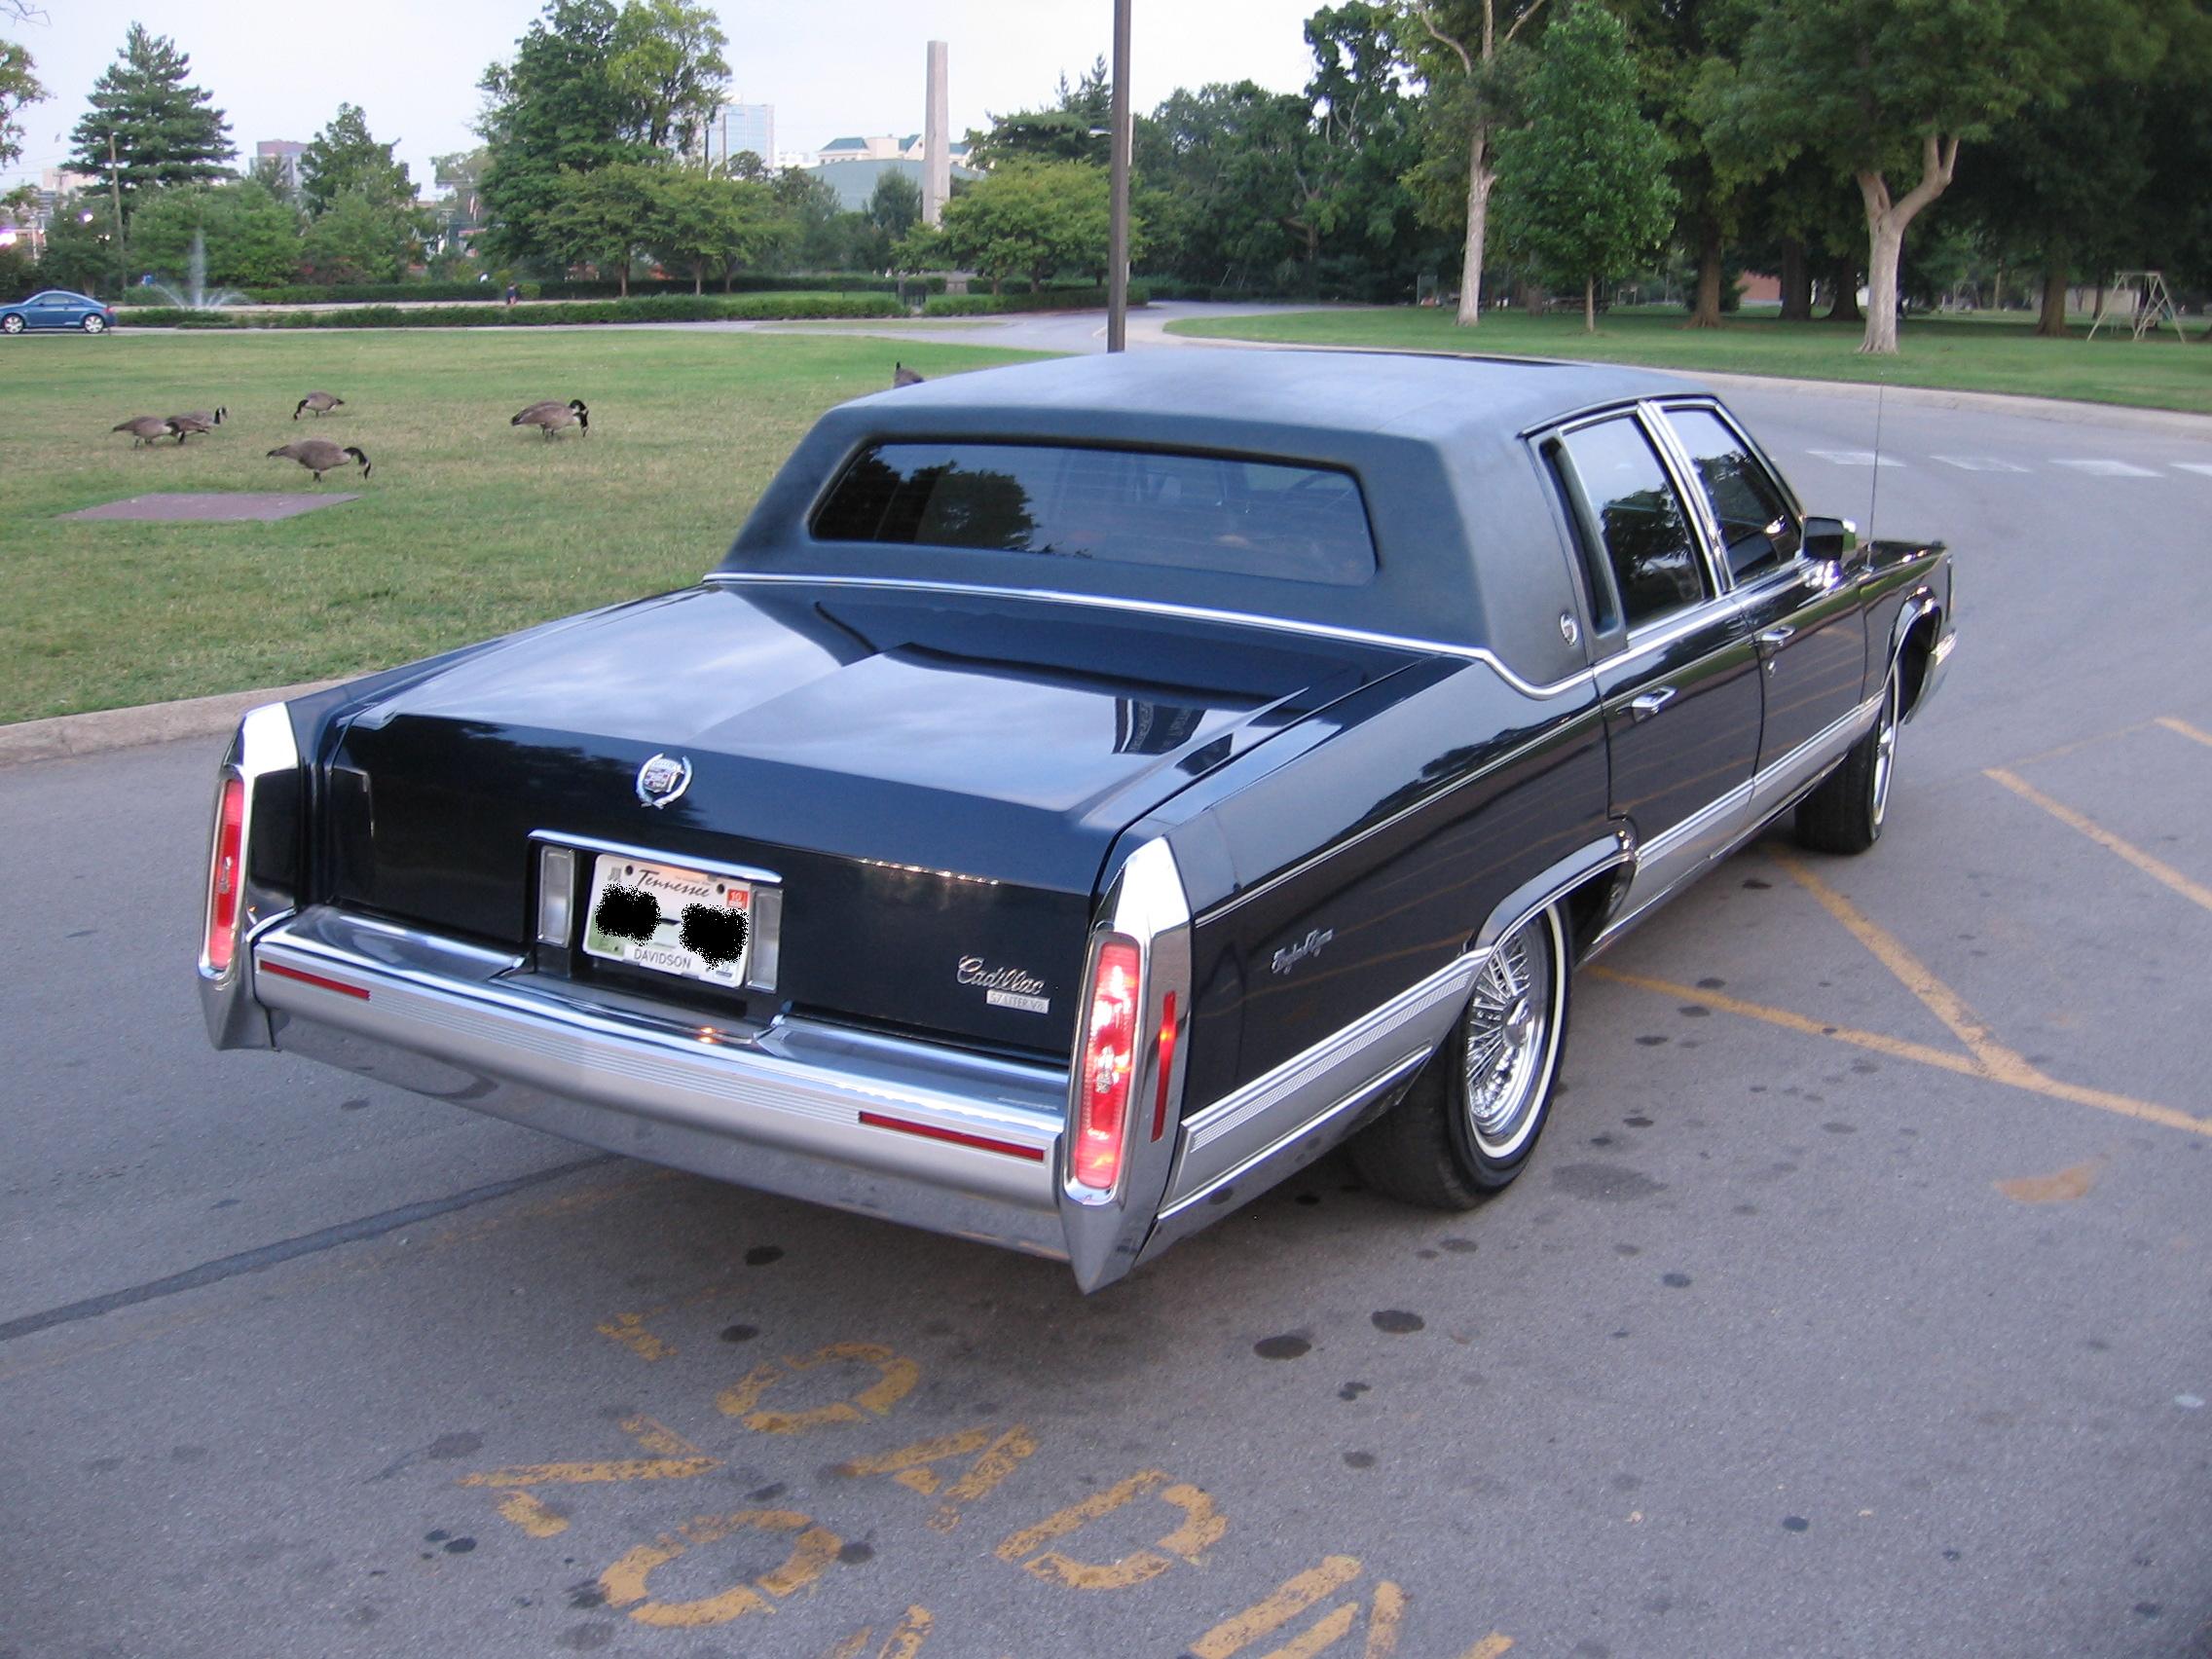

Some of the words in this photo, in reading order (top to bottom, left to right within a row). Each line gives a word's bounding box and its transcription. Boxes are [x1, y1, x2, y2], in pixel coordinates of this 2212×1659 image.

[638, 868, 711, 898] Tennessee
[634, 947, 692, 968] DAVIDSON
[956, 954, 1046, 995] Cadillac
